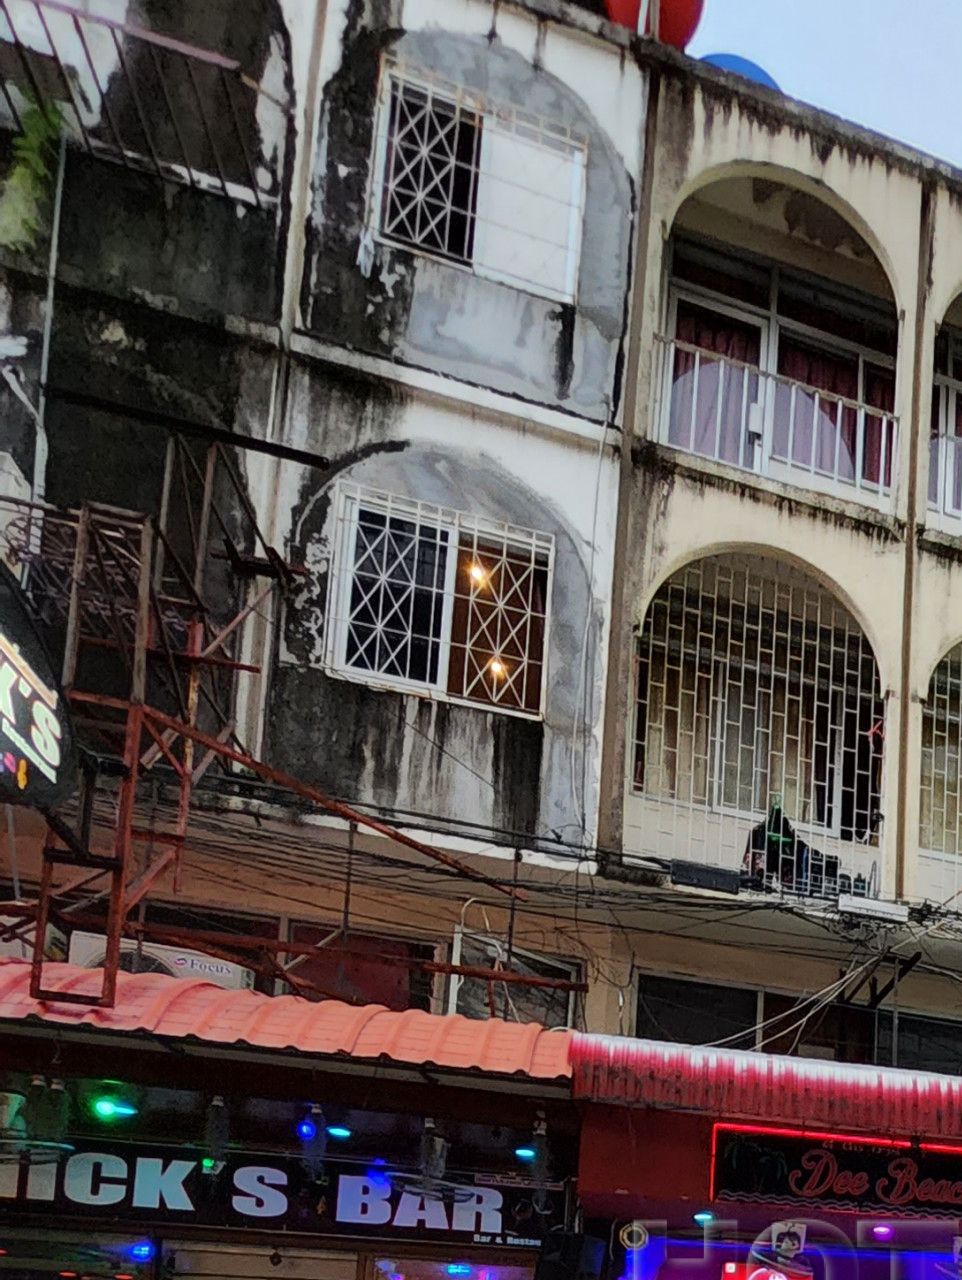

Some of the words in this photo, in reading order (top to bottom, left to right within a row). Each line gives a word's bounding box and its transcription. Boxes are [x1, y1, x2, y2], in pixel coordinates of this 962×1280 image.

[0, 1149, 288, 1218] ICK'S
[336, 1174, 504, 1233] BAR
[788, 1149, 870, 1198] Dee
[506, 1235, 542, 1247] Restau
